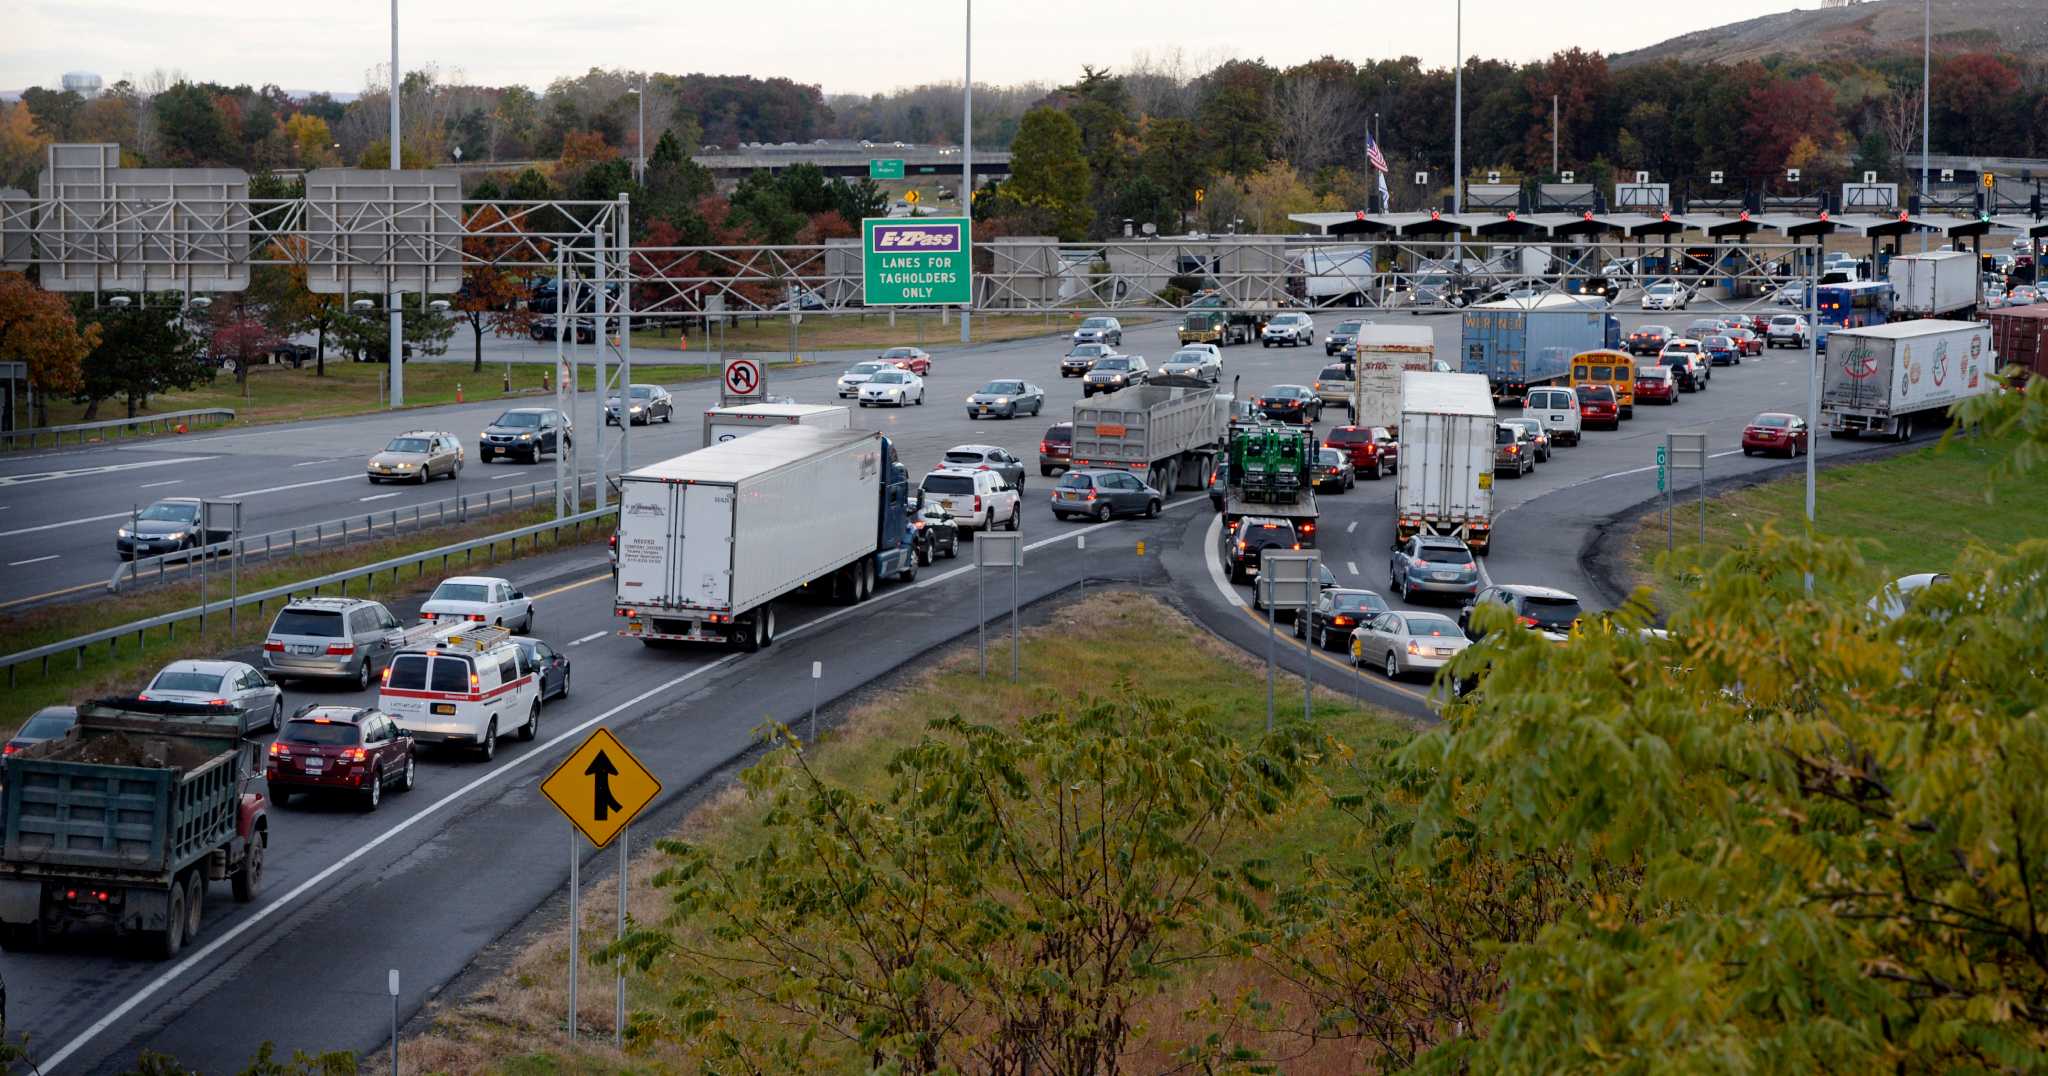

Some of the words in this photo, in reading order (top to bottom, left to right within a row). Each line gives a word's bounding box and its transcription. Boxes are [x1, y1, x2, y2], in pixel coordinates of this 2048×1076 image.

[880, 231, 954, 247] E-ZPass
[882, 257, 921, 269] LANES
[928, 257, 952, 268] FOR
[880, 272, 957, 284] TAGHOLDERS
[902, 287, 933, 298] ONLY
